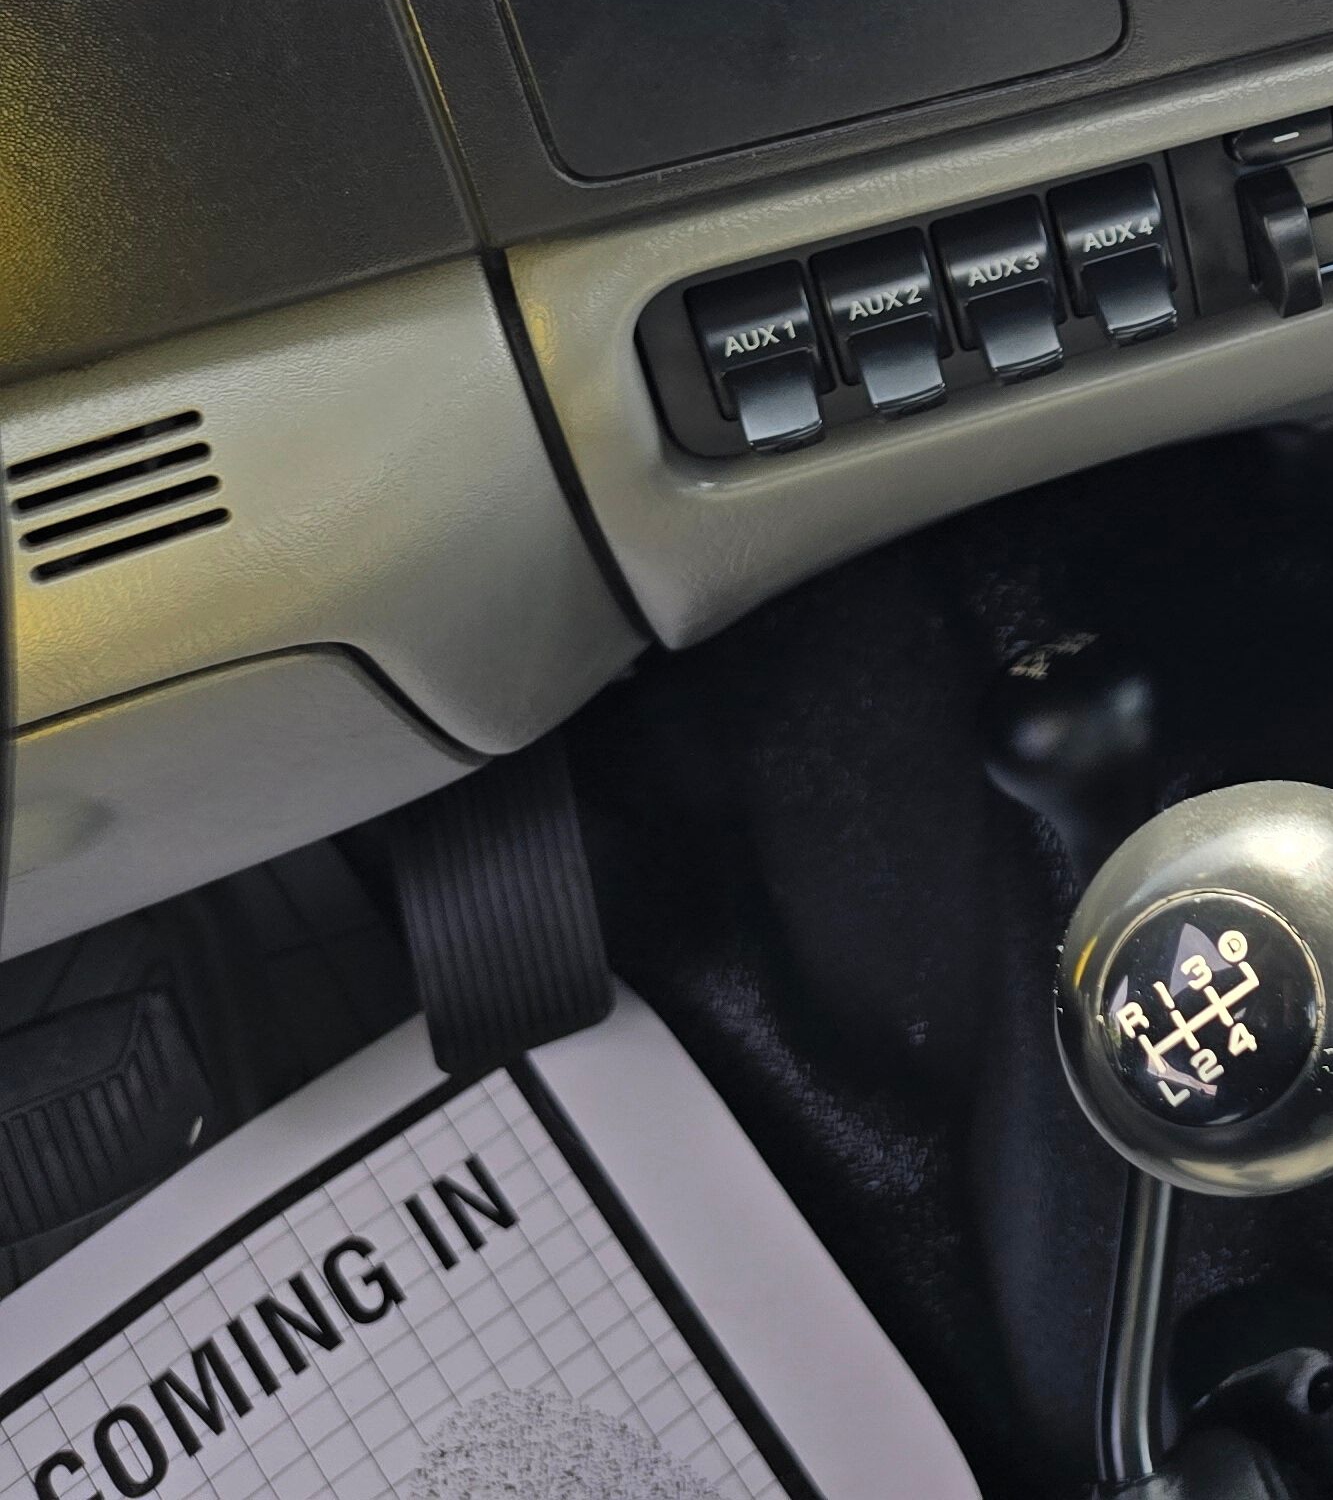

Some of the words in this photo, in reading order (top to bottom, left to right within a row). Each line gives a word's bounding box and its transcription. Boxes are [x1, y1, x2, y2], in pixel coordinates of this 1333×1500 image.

[1082, 222, 1139, 253] AUX
[1136, 216, 1154, 237] 4
[967, 257, 1024, 287] AUX
[1023, 251, 1041, 272] 3
[848, 290, 906, 321] AUX
[905, 284, 923, 305] 2
[724, 325, 781, 358] AUX
[785, 320, 798, 340] 1
[1116, 1002, 1149, 1038] R
[1181, 955, 1212, 990] 3
[1157, 1080, 1191, 1108] L
[1190, 1048, 1225, 1083] 2
[1227, 1023, 1258, 1057] 4
[405, 1154, 519, 1270] IN
